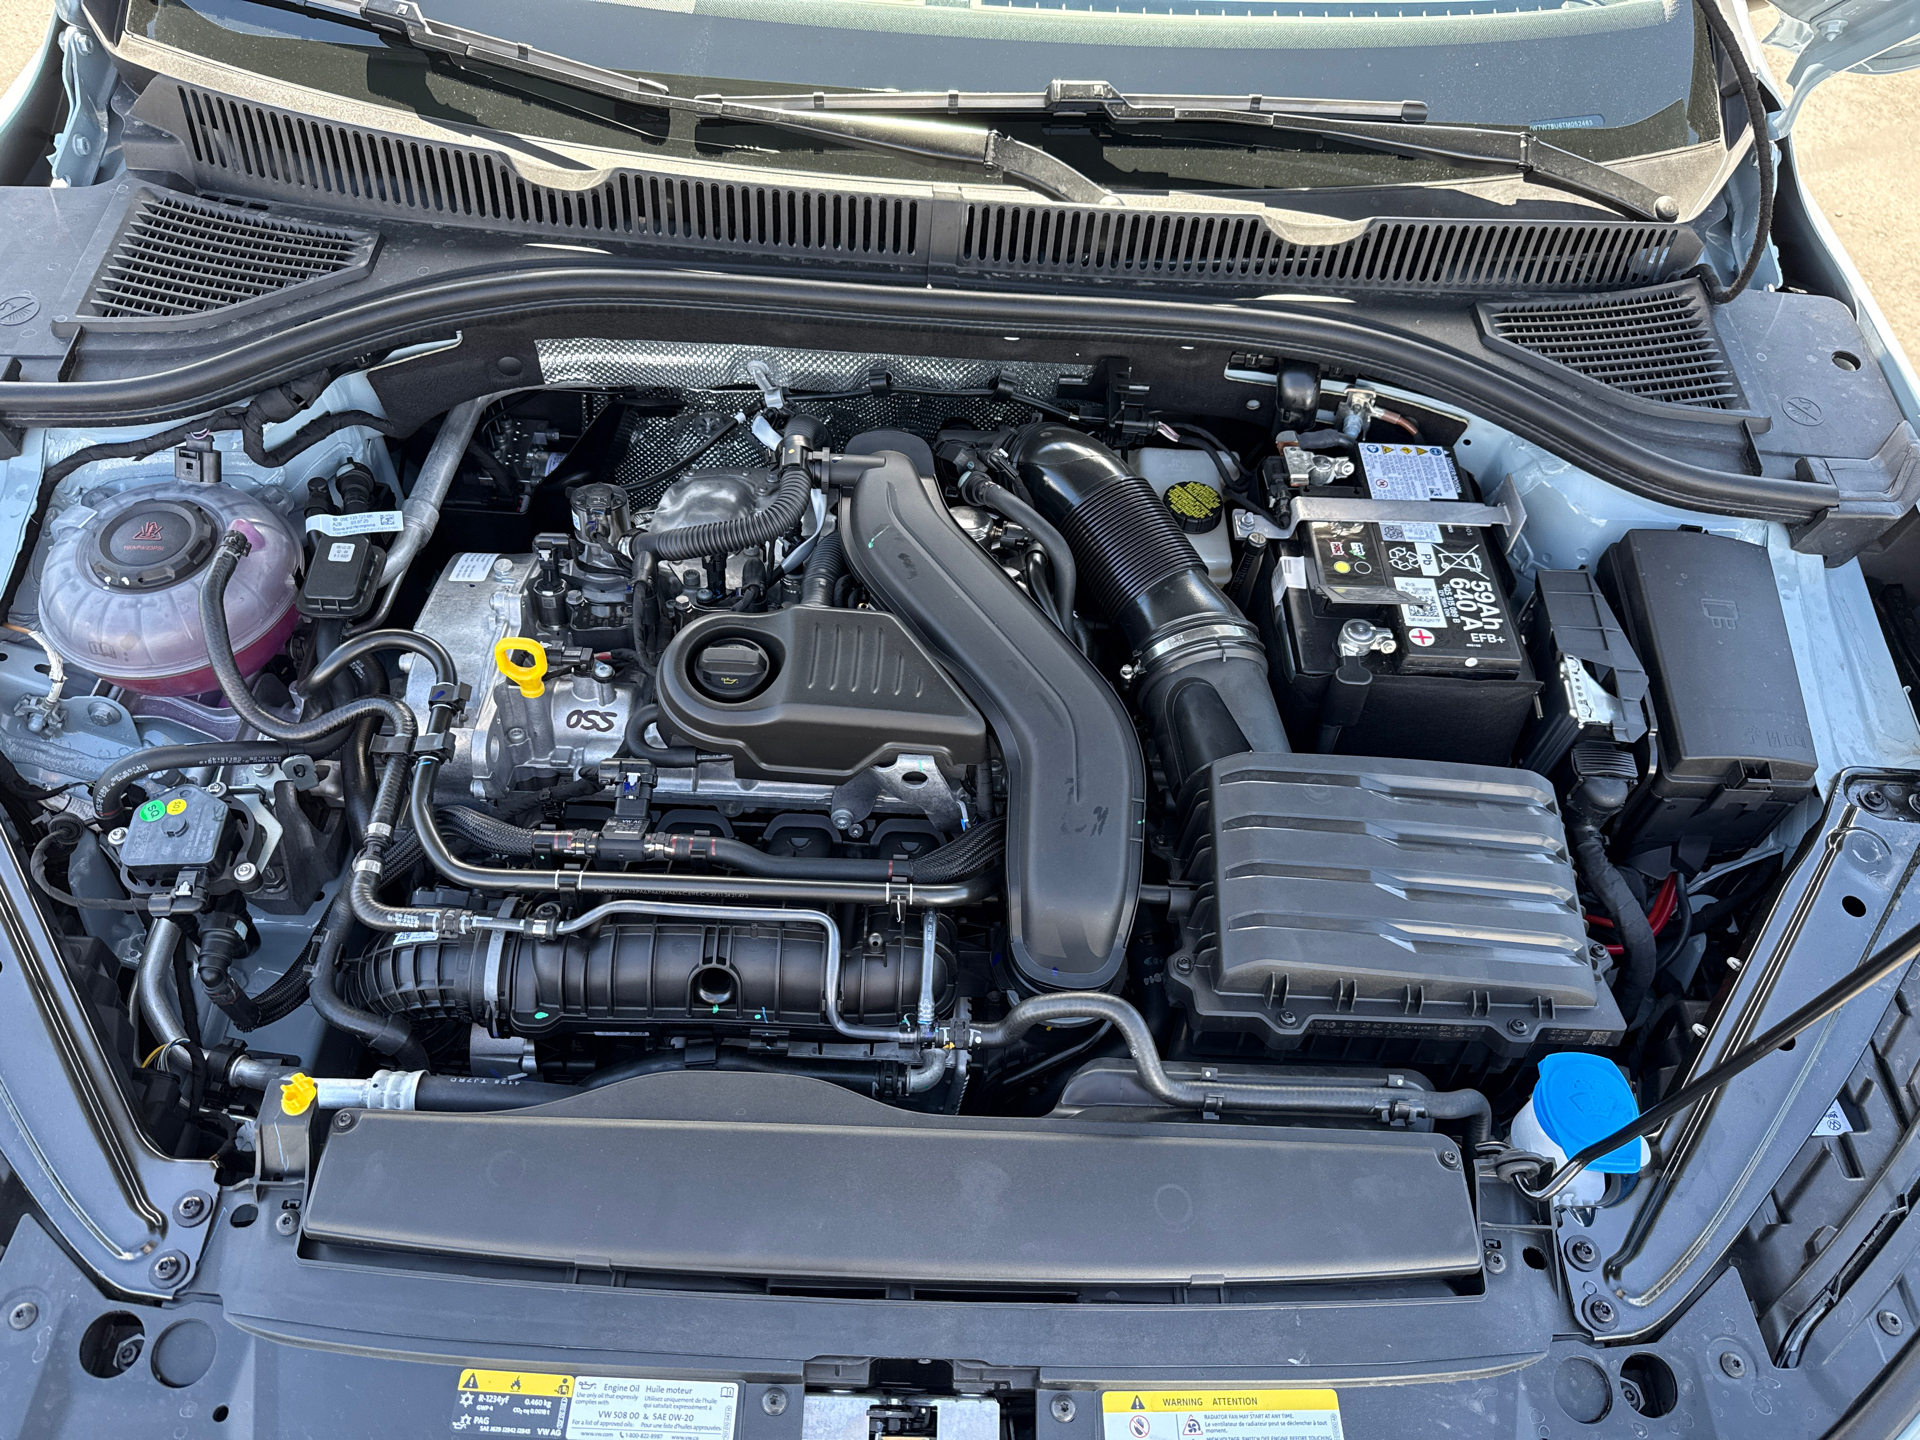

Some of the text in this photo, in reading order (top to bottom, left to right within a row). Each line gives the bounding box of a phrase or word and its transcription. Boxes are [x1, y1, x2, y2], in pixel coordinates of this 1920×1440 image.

[1421, 554, 1433, 566] Pb
[1450, 578, 1478, 612] 640
[1470, 580, 1503, 630] 59Ah
[1460, 616, 1483, 631] A
[1470, 632, 1506, 644] EFB+
[147, 804, 160, 818] SQ
[604, 1383, 628, 1393] Engine
[646, 1385, 665, 1393] Huile
[478, 1394, 552, 1408] R-1234yf 0.460 kg
[575, 1398, 597, 1406] complies
[1162, 1397, 1203, 1406] WARNING
[1212, 1397, 1258, 1406] ATTENTION
[473, 1416, 490, 1425] PAG
[598, 1410, 612, 1418] VW
[613, 1411, 628, 1419] 508
[668, 1414, 694, 1422] 0W-20
[537, 1428, 550, 1436] VW
